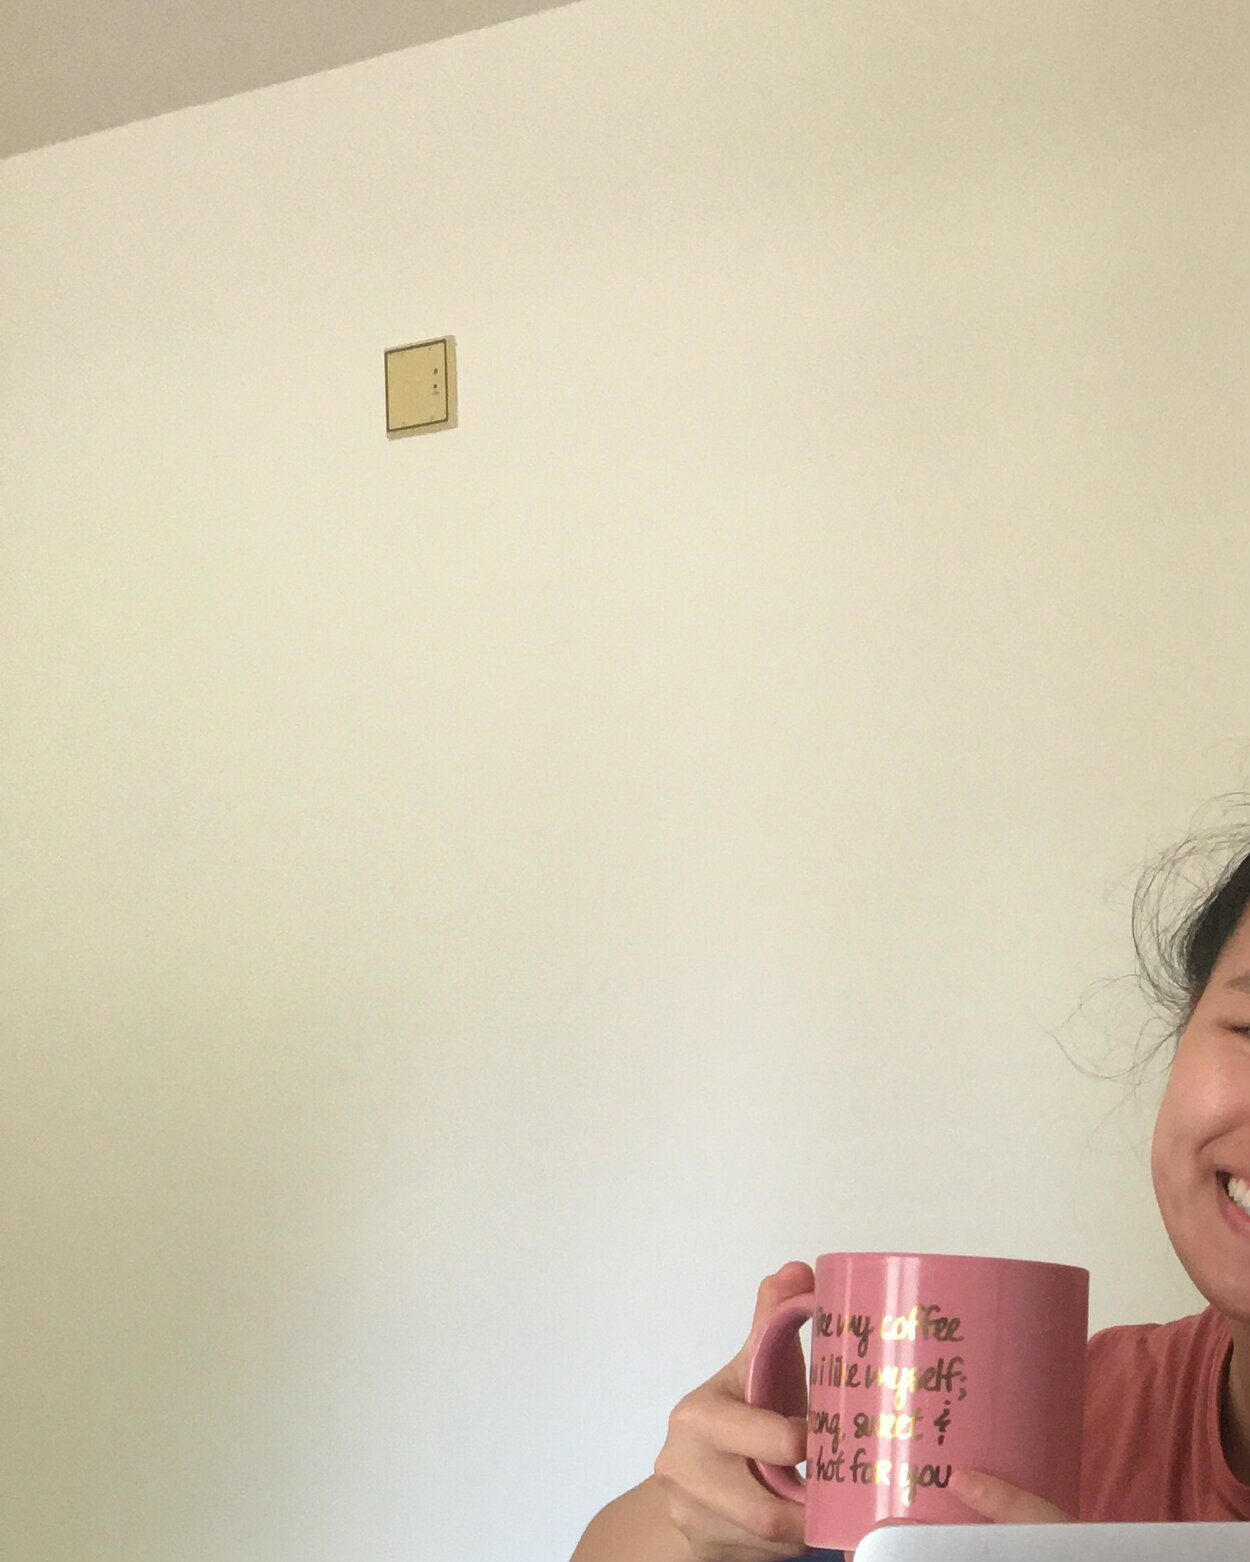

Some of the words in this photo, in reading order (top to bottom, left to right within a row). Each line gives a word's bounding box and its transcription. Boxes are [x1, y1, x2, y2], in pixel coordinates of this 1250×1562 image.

[836, 1313, 874, 1359] my
[880, 1303, 965, 1342] coffee
[828, 1353, 862, 1388] like
[853, 1407, 924, 1440] sweet
[816, 1445, 845, 1484] hot
[897, 1462, 952, 1508] you
